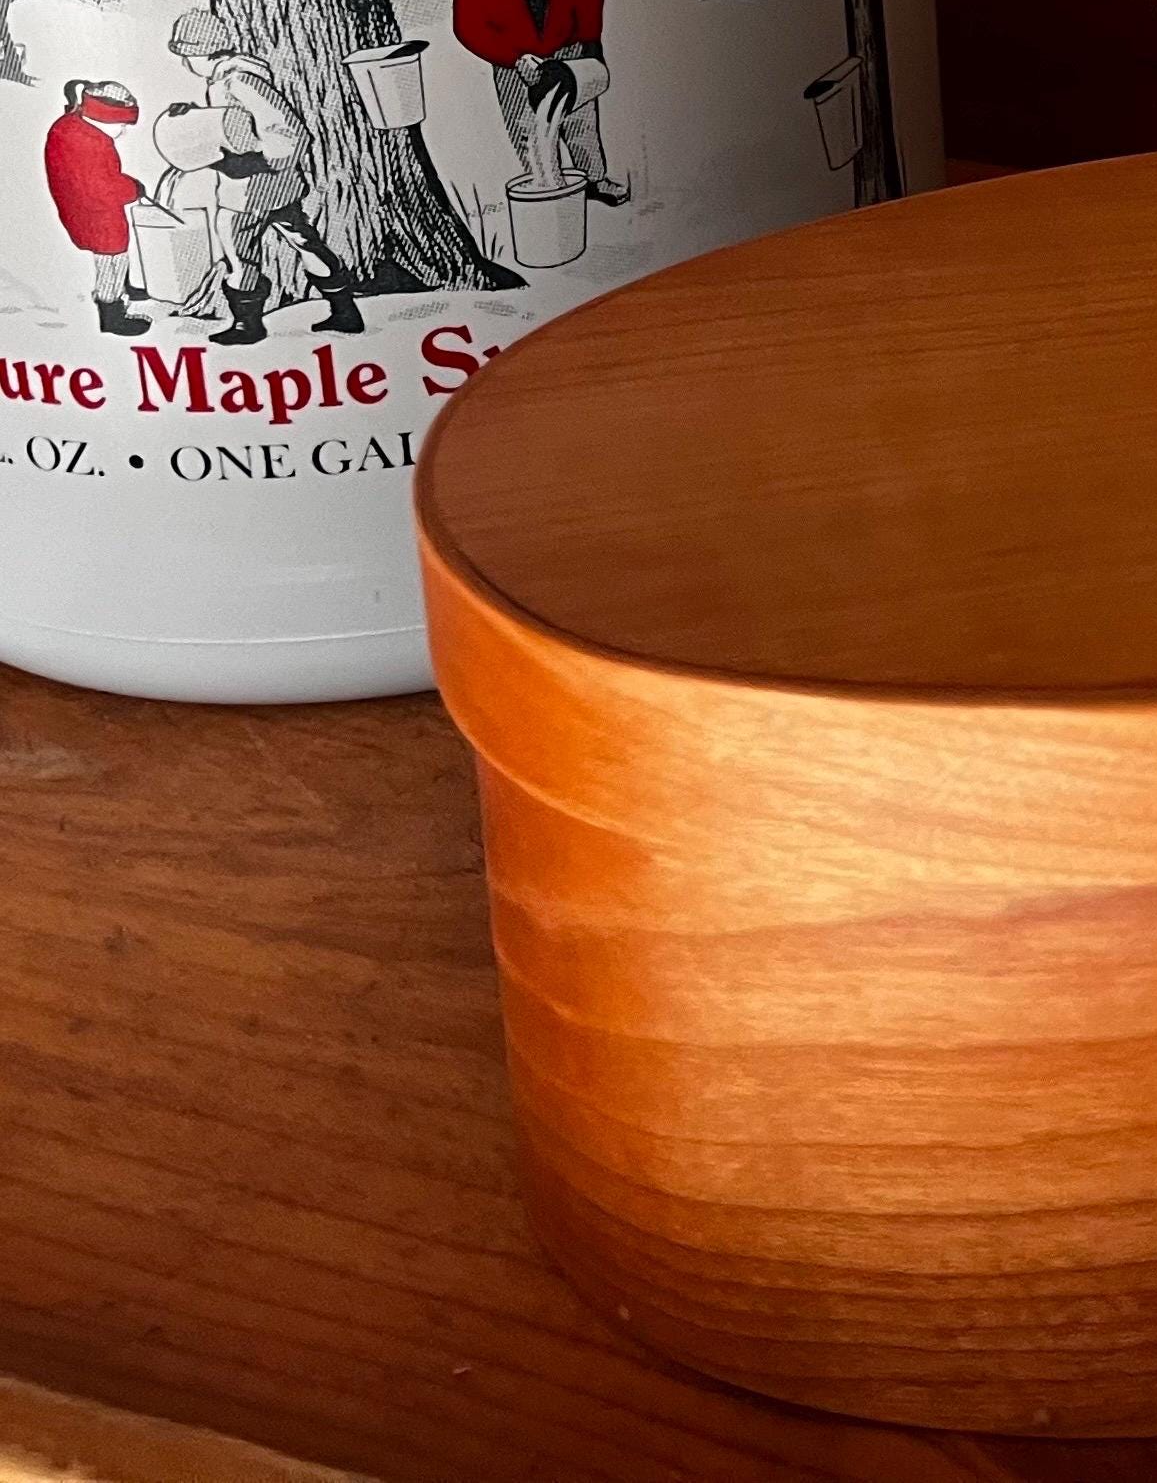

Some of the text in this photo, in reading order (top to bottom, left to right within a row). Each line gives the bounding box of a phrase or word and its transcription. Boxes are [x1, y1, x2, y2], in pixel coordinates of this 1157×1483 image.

[131, 344, 388, 426] Maple
[27, 436, 105, 476] OZ.
[170, 444, 296, 480] ONE
